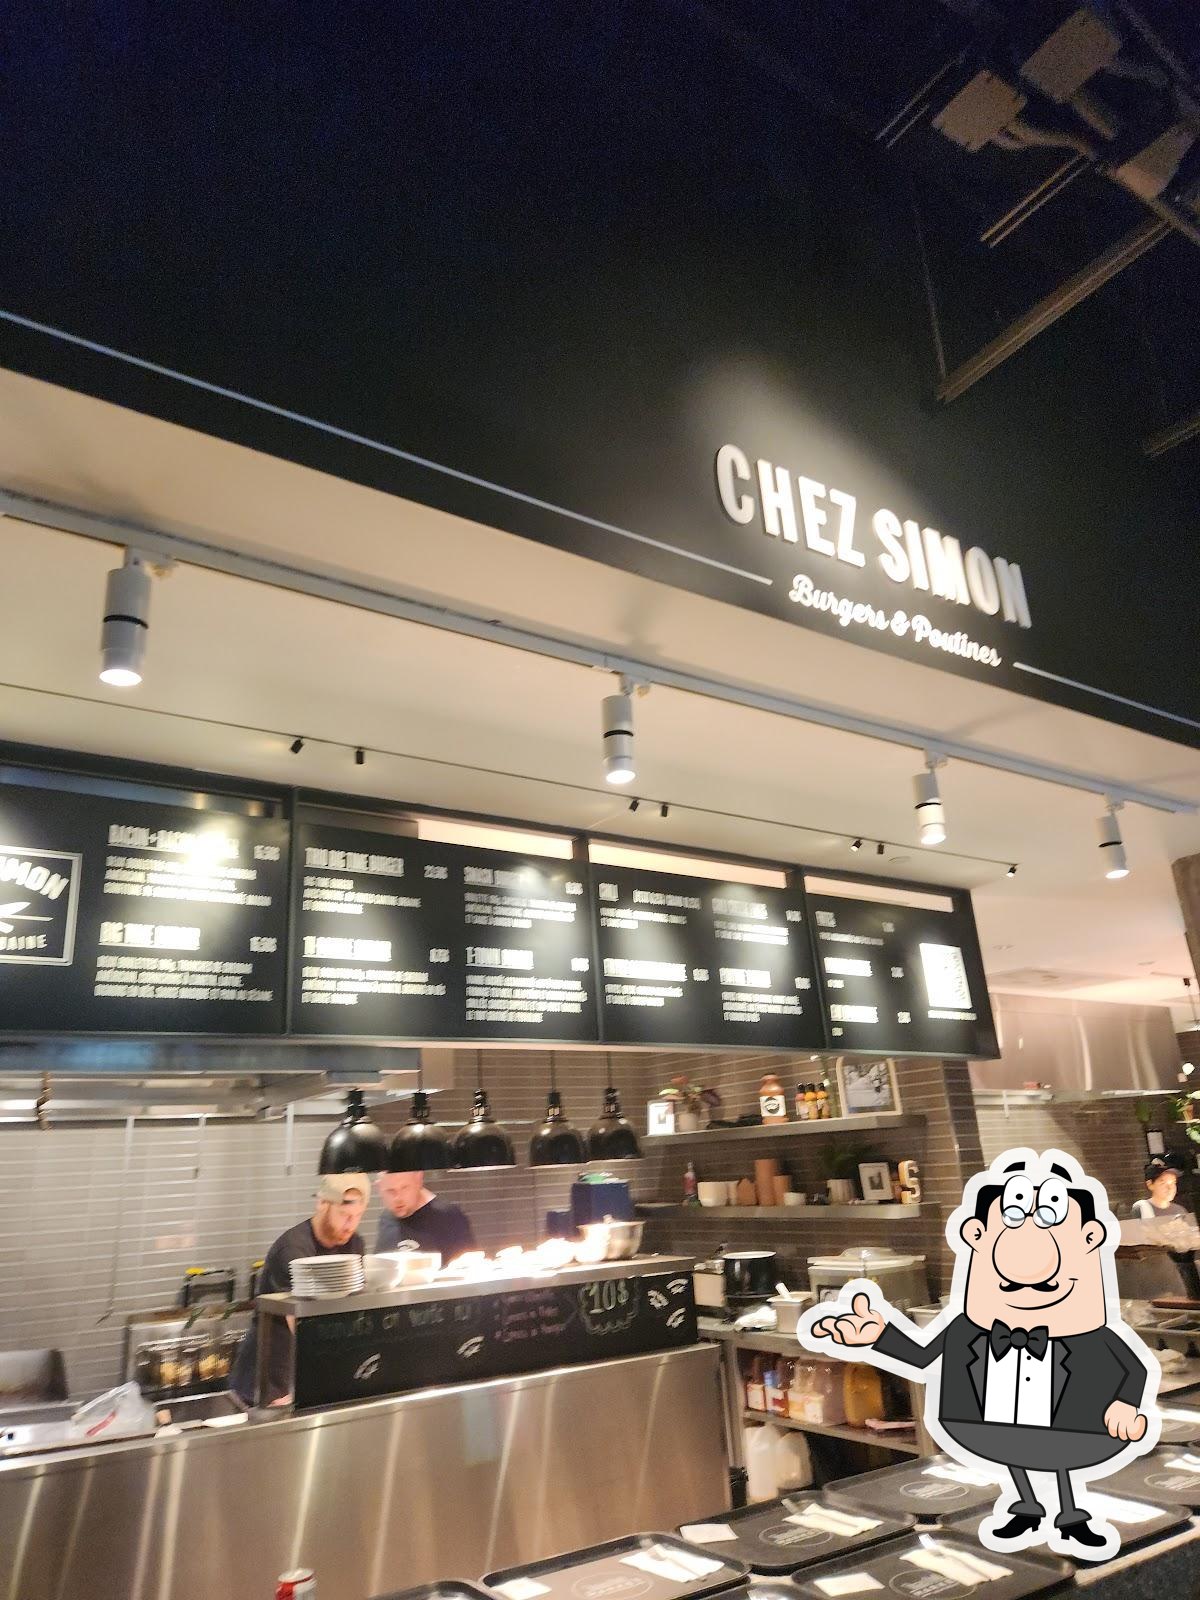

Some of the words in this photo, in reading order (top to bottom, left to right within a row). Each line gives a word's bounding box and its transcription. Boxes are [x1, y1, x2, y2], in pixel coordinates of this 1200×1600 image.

[716, 444, 866, 568] CHEZ
[871, 508, 1032, 629] SIMON
[788, 573, 890, 627] Burgers
[889, 610, 912, 637] &
[910, 614, 1002, 667] Poutines
